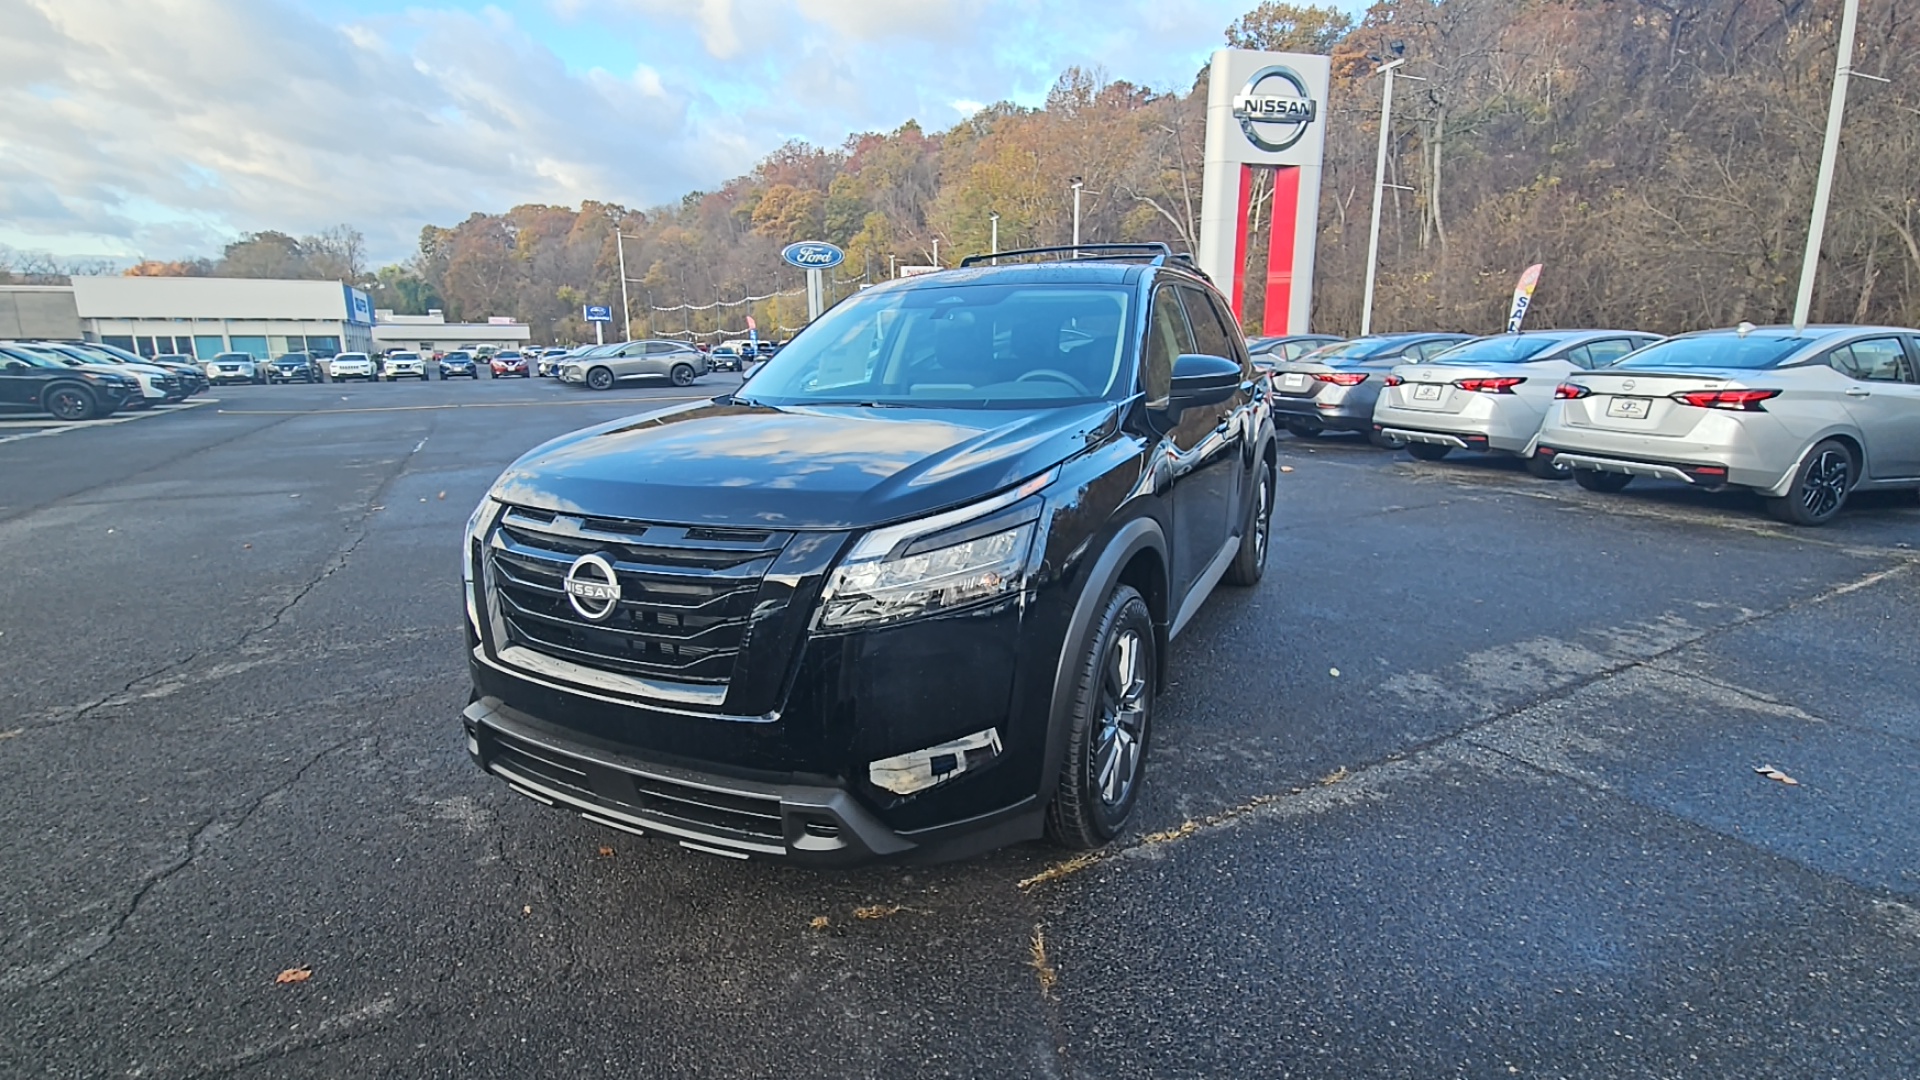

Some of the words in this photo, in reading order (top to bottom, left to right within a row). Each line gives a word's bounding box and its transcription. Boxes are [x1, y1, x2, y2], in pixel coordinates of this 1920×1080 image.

[1243, 99, 1310, 115] NISSAN
[797, 246, 832, 263] Ford
[564, 580, 618, 598] NISSAN
